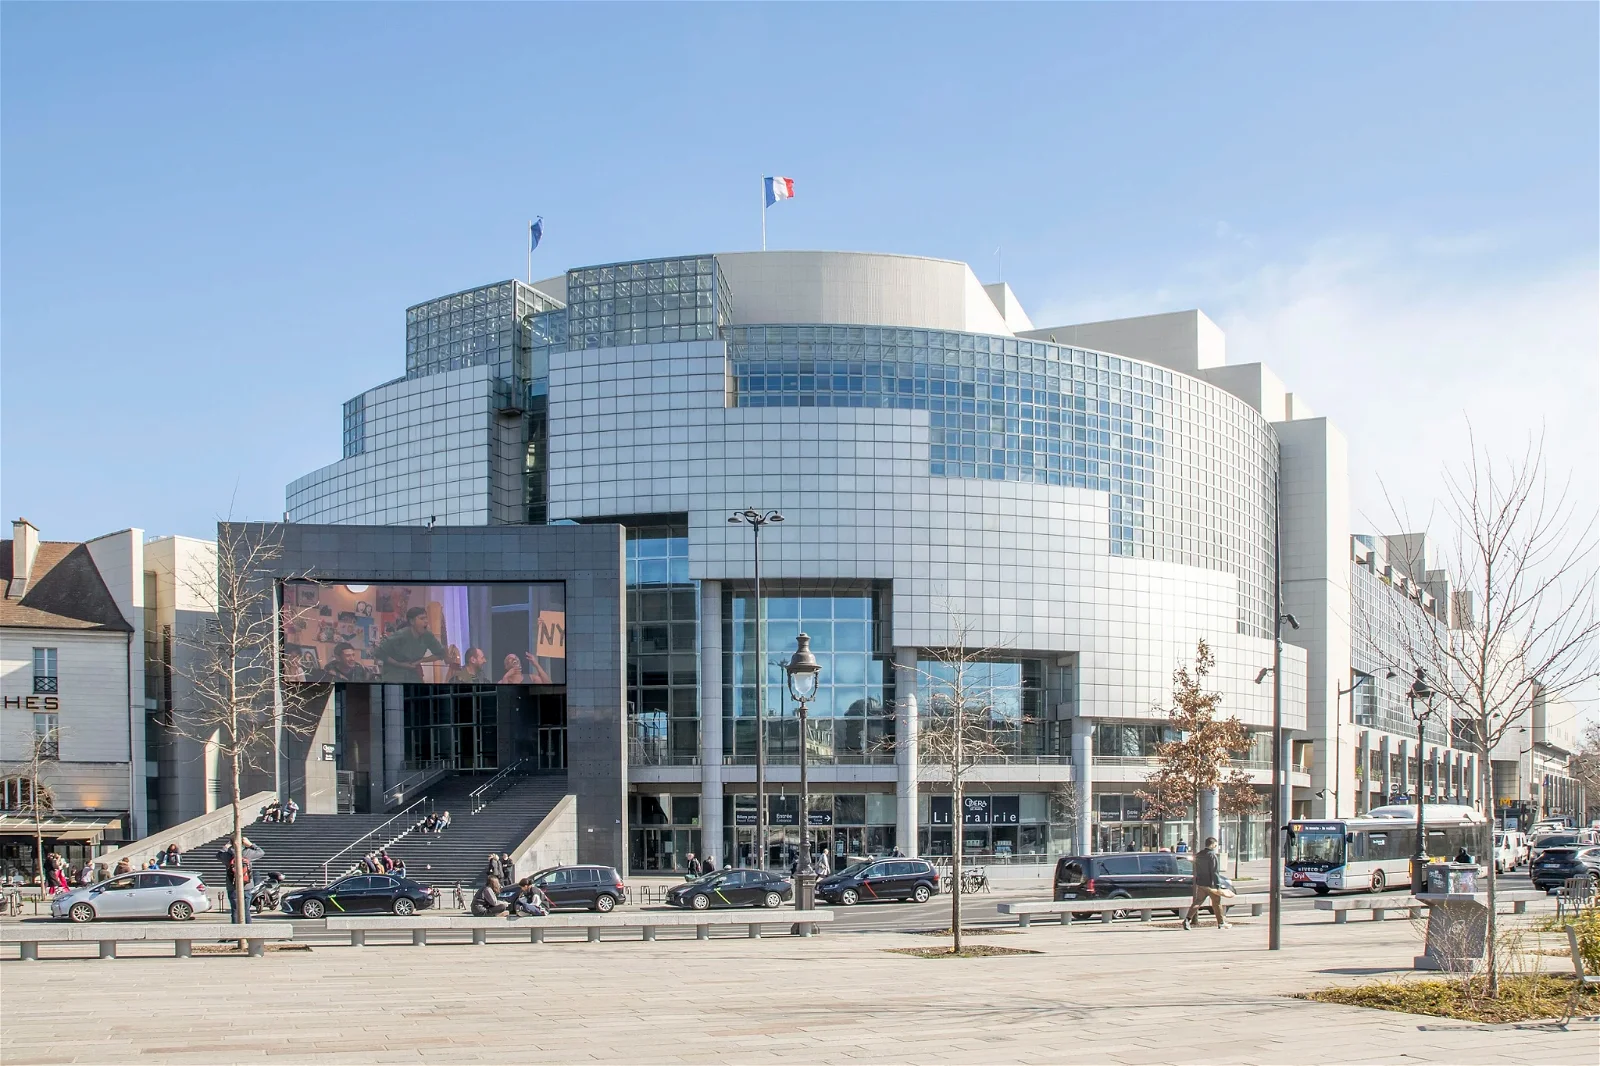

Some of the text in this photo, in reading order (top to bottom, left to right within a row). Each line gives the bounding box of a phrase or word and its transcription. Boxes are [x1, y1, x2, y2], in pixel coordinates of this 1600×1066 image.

[540, 622, 565, 647] NY
[4, 696, 58, 709] HES
[933, 811, 1017, 823] Lirairie
[1293, 824, 1302, 832] 87
